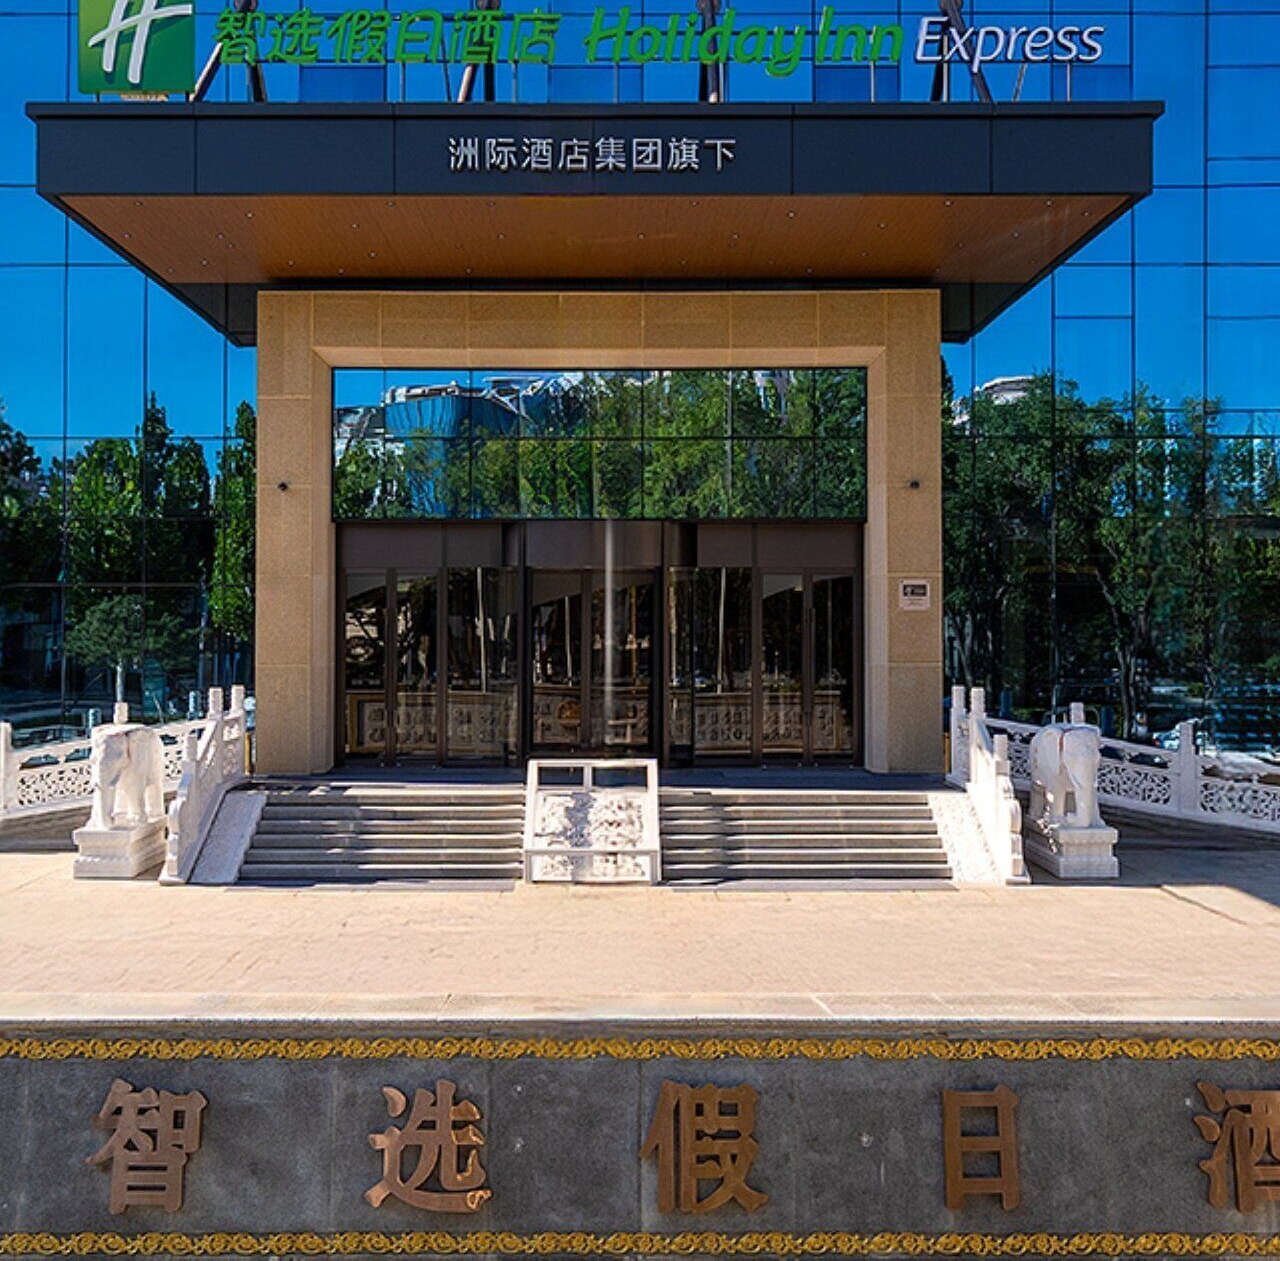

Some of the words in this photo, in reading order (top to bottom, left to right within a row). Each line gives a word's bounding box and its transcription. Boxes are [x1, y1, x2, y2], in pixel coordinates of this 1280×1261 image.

[214, 7, 562, 65] 智选假日酒店
[914, 16, 1106, 74] Express
[447, 136, 738, 172] 洲际酒店集团旗下
